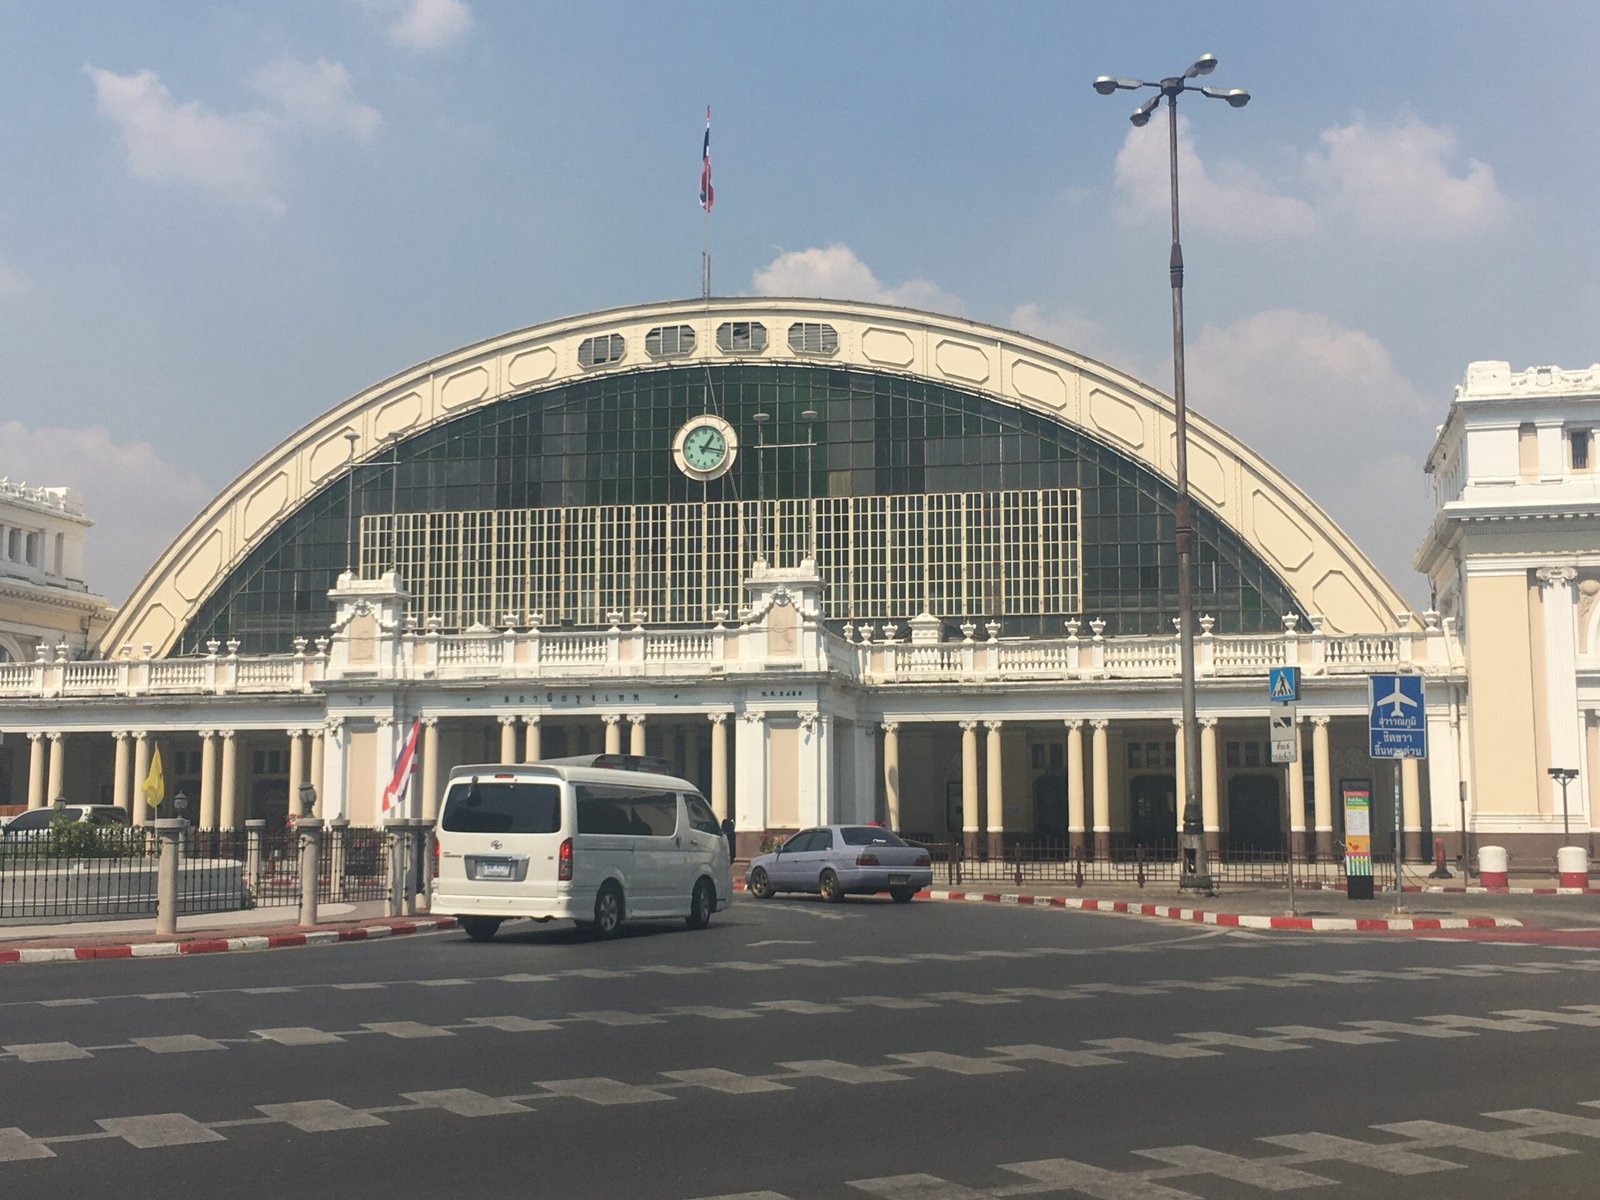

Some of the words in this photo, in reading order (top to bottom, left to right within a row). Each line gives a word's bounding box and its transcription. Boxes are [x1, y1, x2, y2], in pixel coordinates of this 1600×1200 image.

[1378, 716, 1417, 729] สุวรรณภูมิ
[1383, 730, 1413, 742] ชิดขวา
